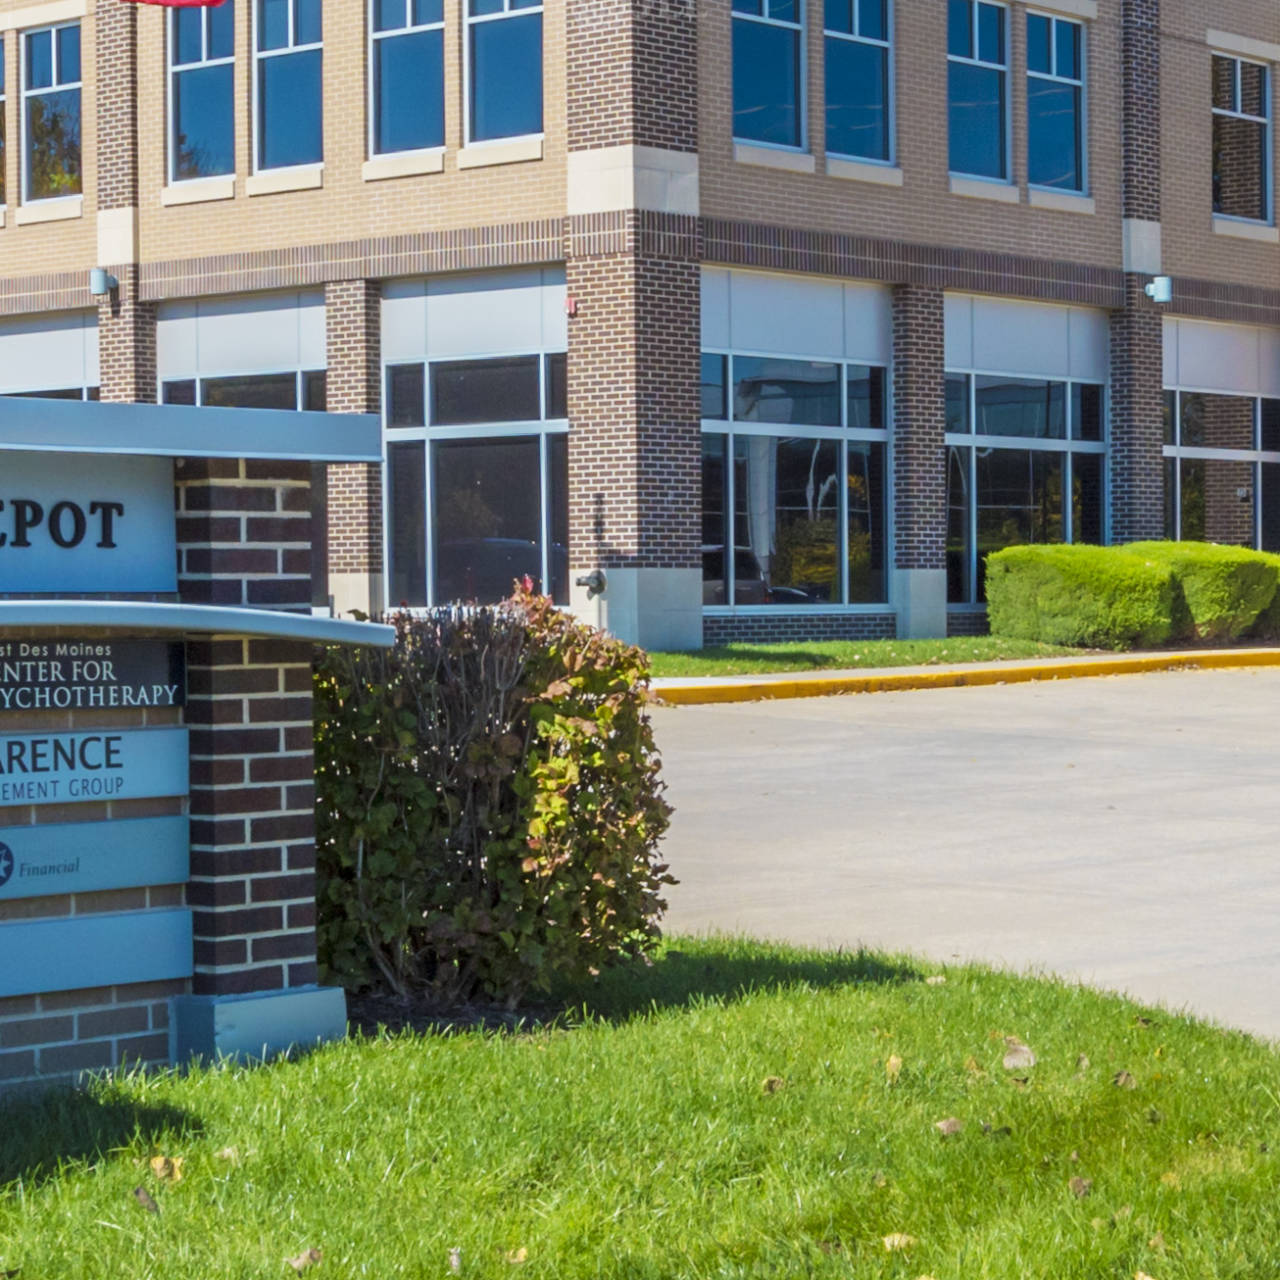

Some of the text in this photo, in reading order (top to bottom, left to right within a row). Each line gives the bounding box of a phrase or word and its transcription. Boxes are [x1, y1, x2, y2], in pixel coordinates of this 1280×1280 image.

[20, 643, 48, 657] Des
[56, 643, 112, 656] Moines
[72, 660, 117, 681] FOR
[70, 777, 124, 797] GROUP
[19, 857, 80, 878] Financial
